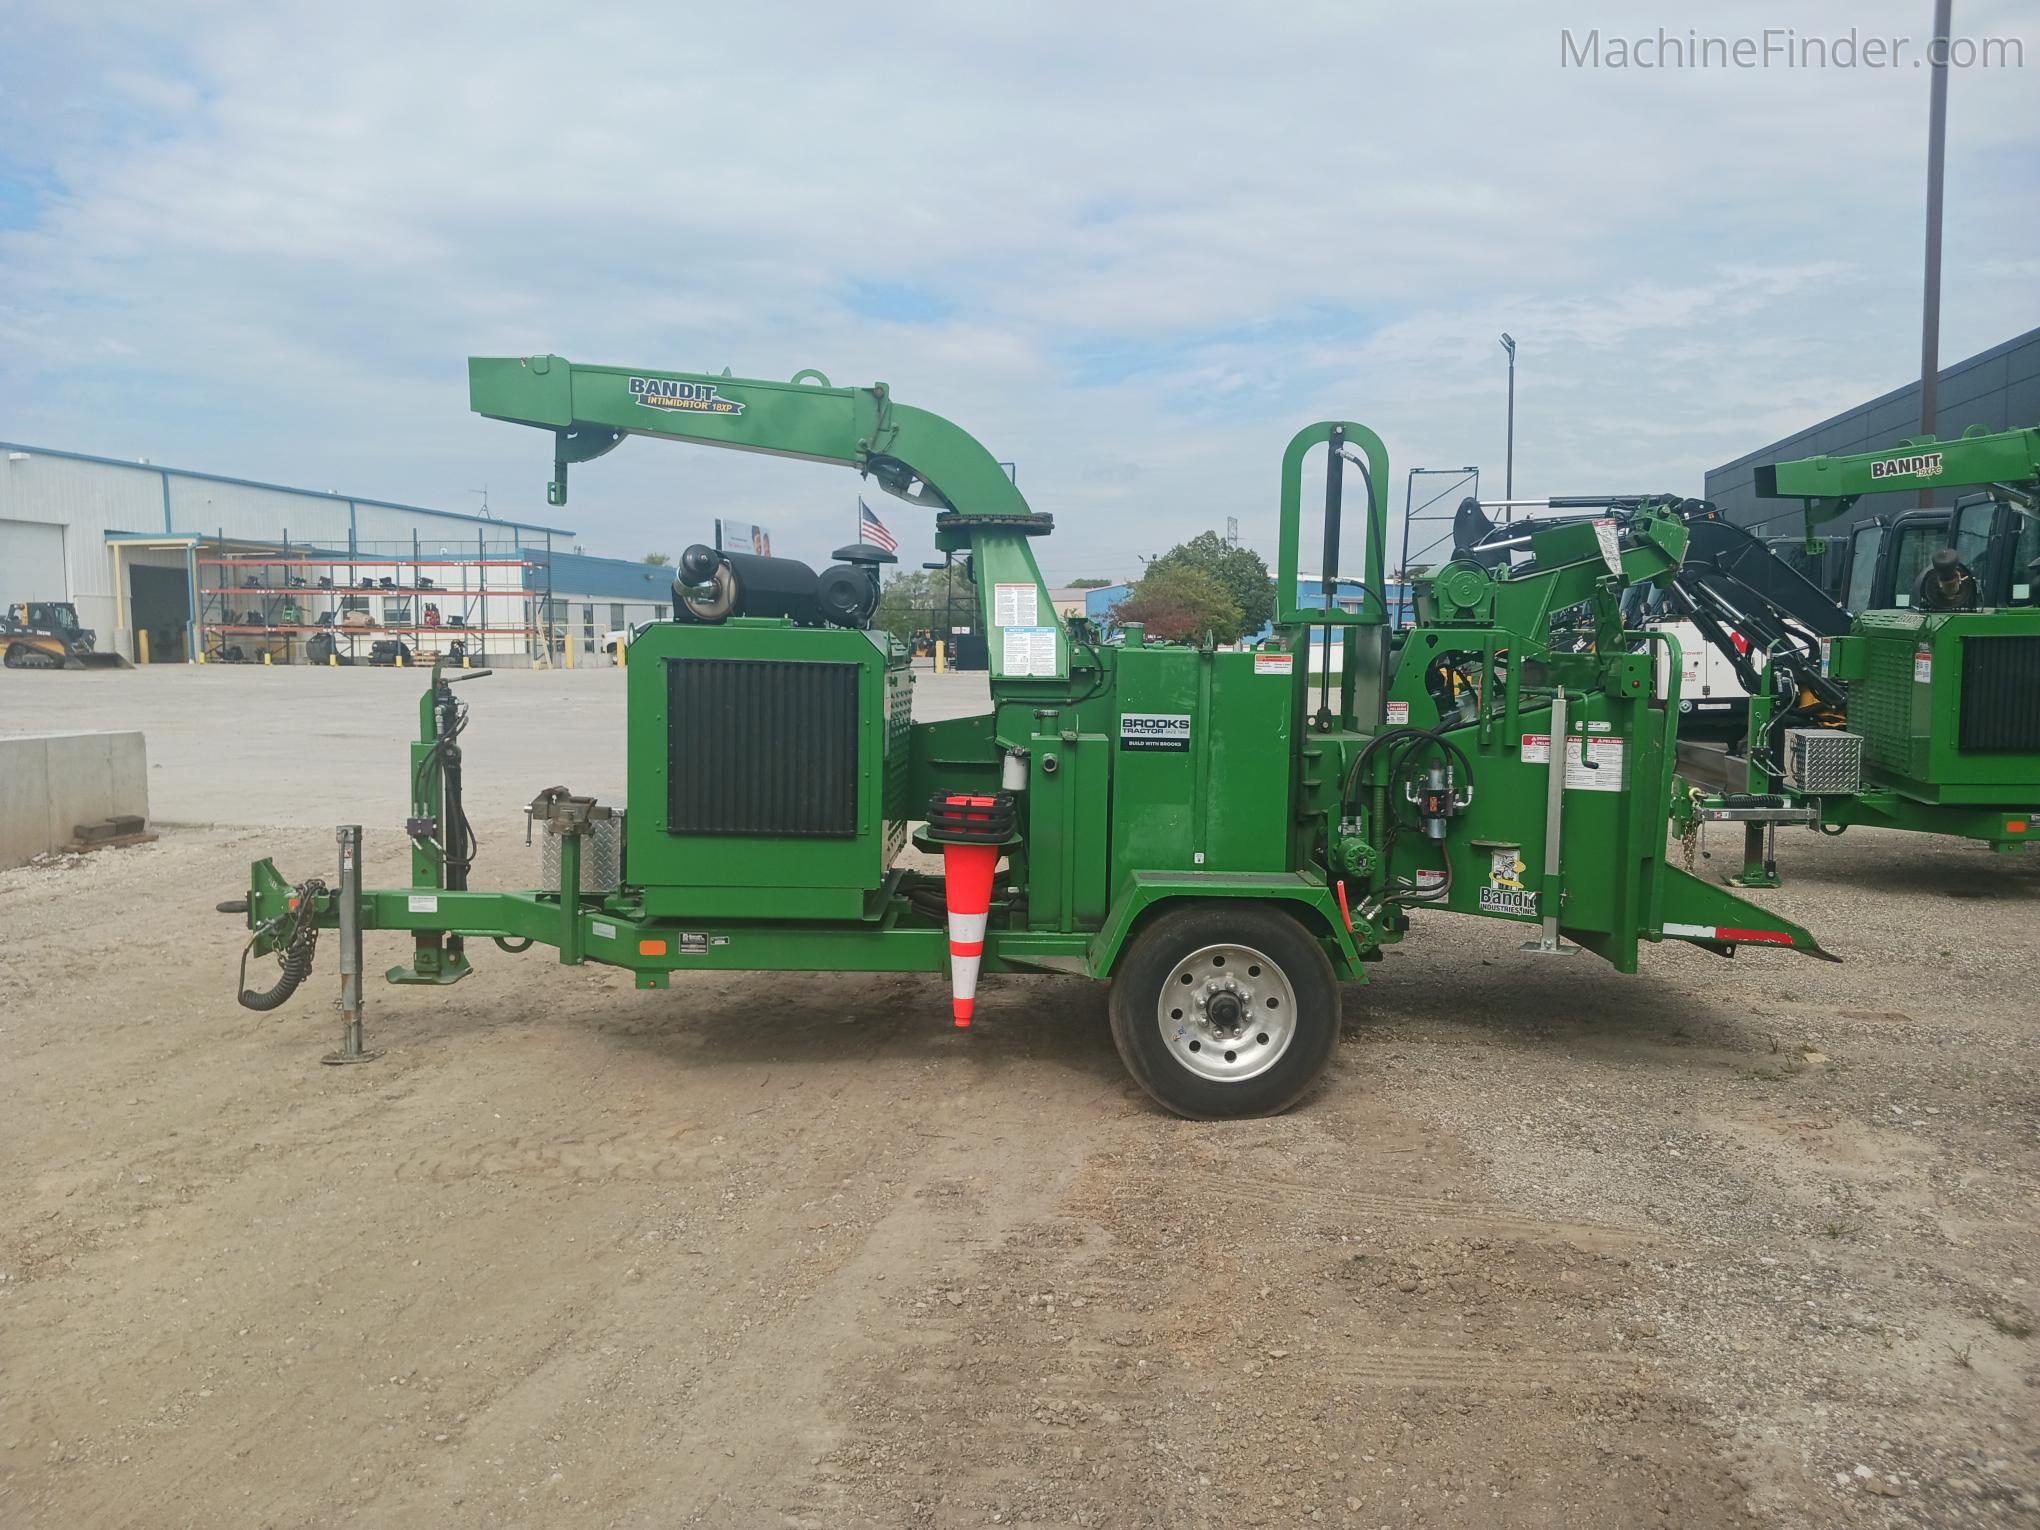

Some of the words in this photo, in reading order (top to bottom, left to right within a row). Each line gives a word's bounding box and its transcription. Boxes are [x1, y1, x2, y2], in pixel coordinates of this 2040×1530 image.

[629, 377, 717, 402] BANDIT
[647, 396, 709, 410] INTIMIDATOR
[712, 402, 733, 412] 18XP
[1871, 453, 1942, 478] BANDIT
[1122, 718, 1190, 730] BROOKS
[1480, 887, 1537, 910] Bandit
[1480, 903, 1522, 916] INDUSTRIES,
[1522, 907, 1538, 916] INC.
